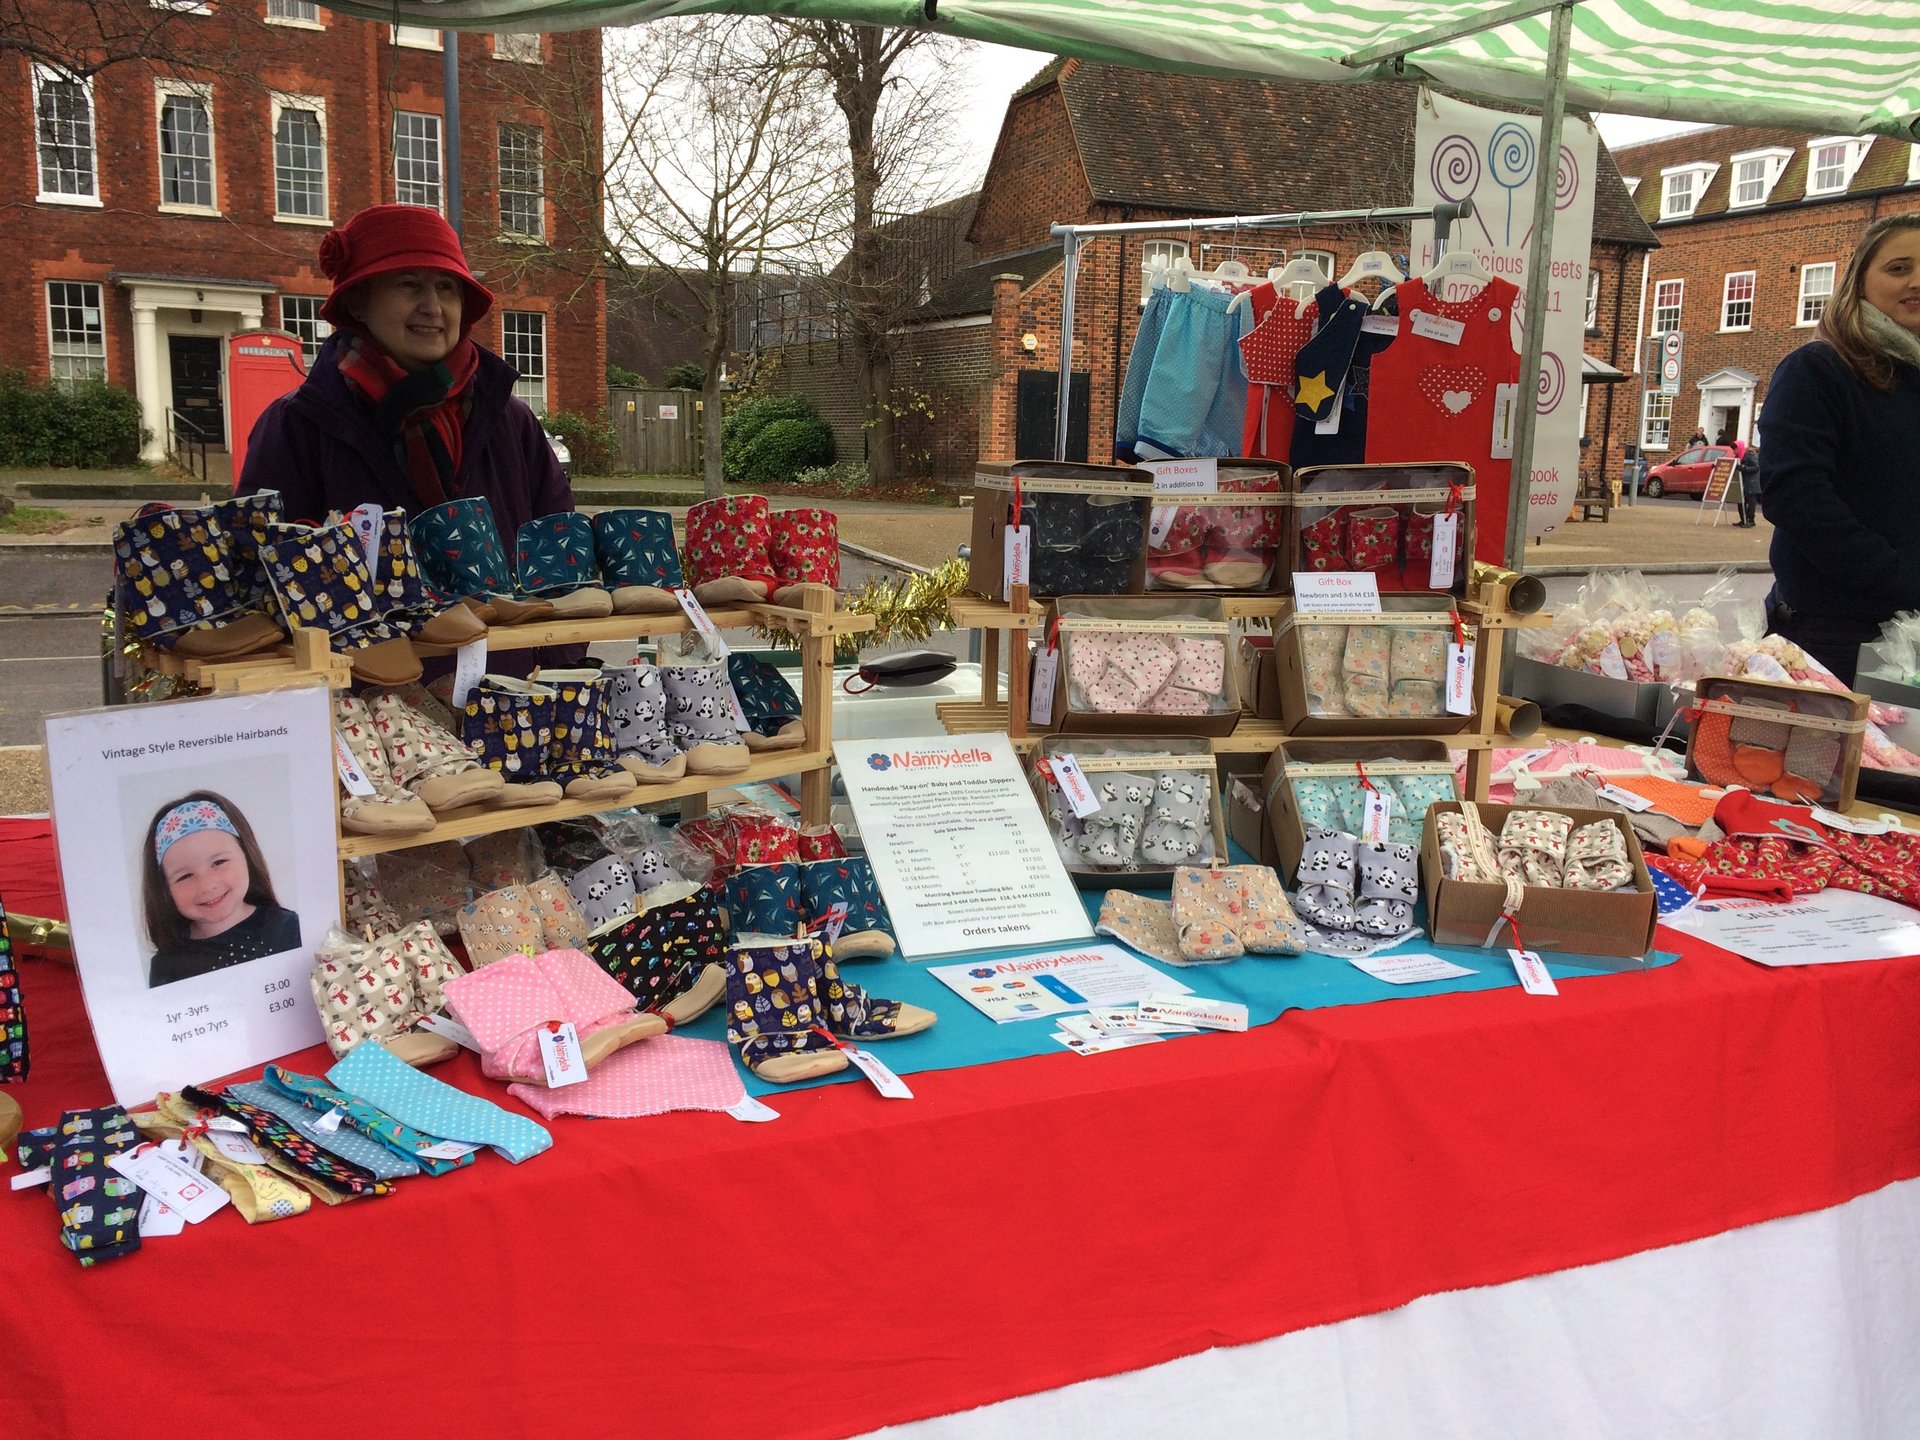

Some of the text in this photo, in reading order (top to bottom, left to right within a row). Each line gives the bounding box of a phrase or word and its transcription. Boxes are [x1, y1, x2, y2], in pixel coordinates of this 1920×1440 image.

[1156, 466, 1198, 475] Gift Boxes
[1169, 480, 1196, 488] addition
[1318, 578, 1352, 586] Gift Box
[102, 726, 288, 760] Vintage Style Reversible Hairbands
[893, 748, 992, 769] Nannydella
[1737, 906, 1830, 920] SALE RAIL
[962, 923, 1031, 936] Orders takens
[996, 953, 1104, 974] Nannydella
[264, 978, 291, 995] £3.00
[269, 997, 295, 1013] £3.00
[166, 1003, 209, 1024] 1yr -3yrs
[171, 1018, 228, 1044] 4yrs to 7yrs
